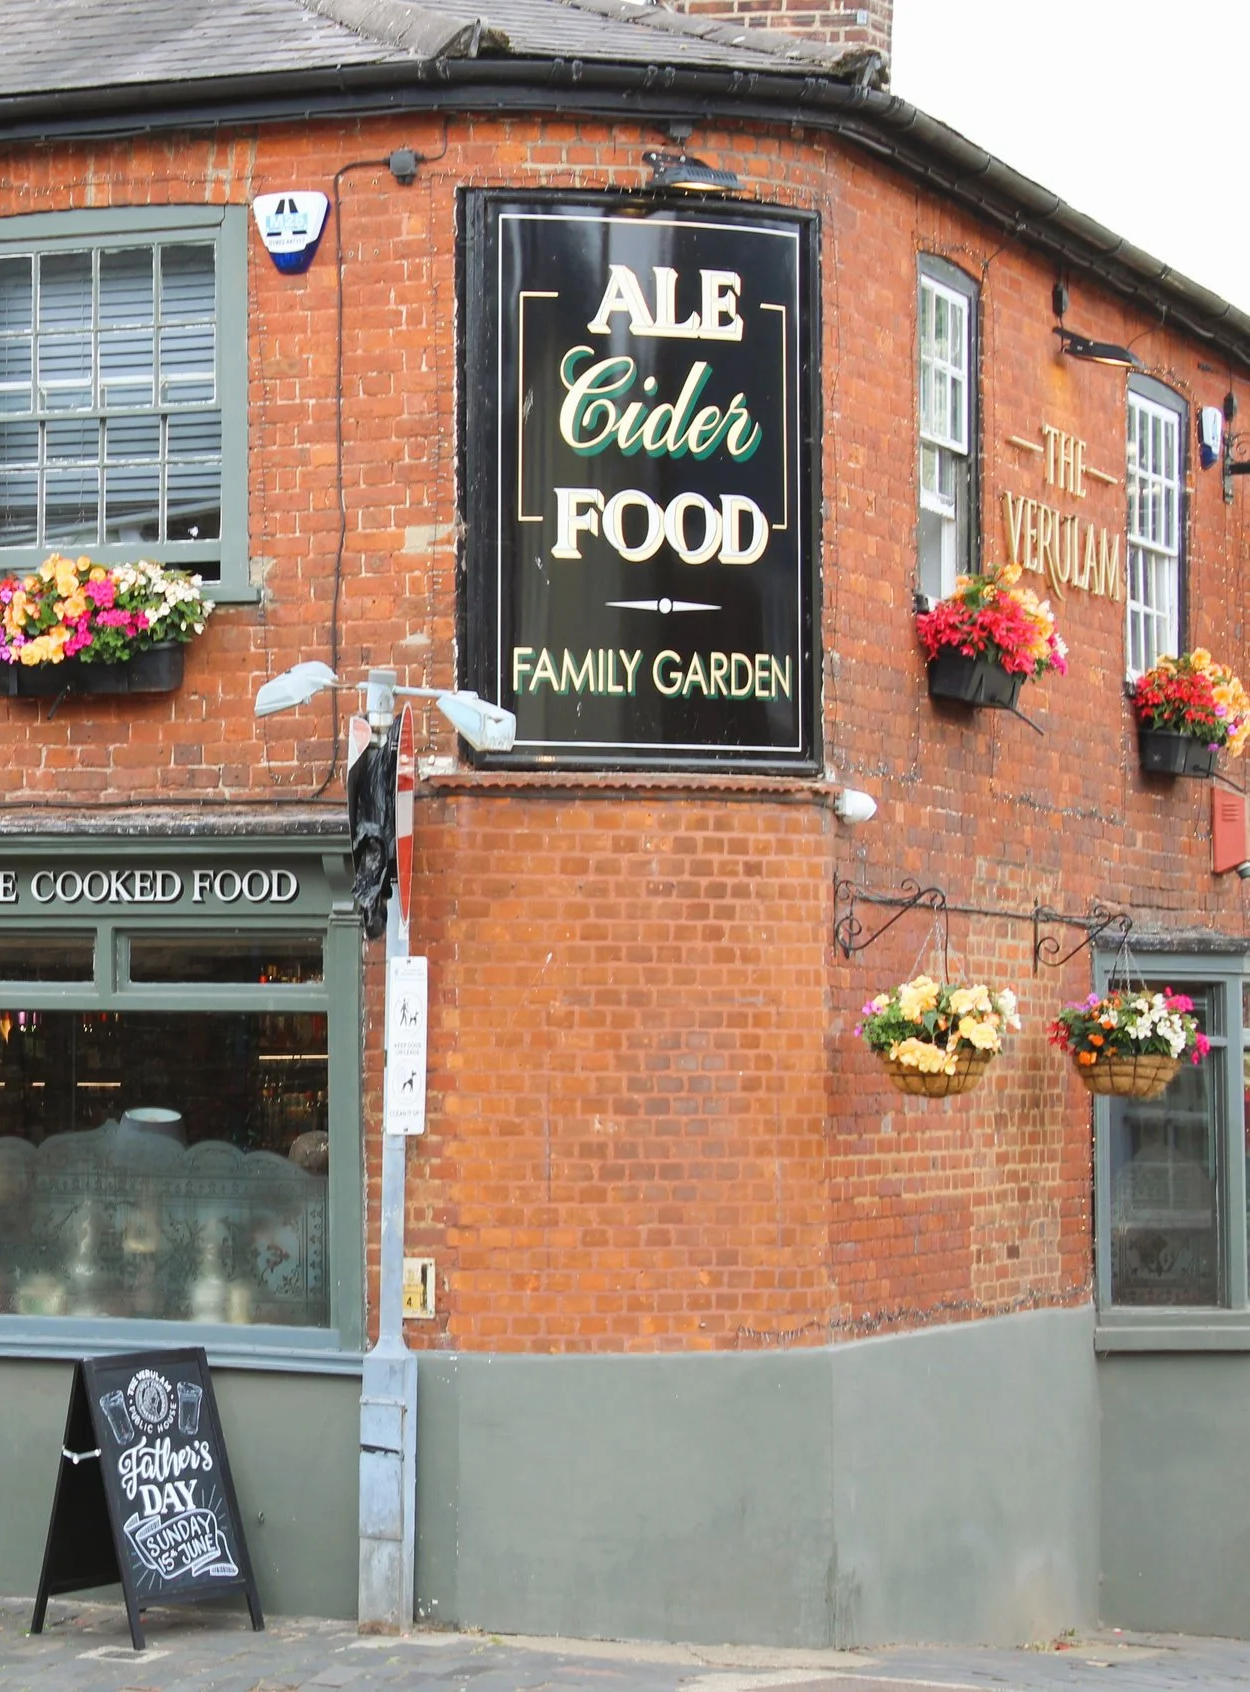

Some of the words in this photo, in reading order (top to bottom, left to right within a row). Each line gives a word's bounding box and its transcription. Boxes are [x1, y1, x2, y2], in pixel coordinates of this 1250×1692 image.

[588, 264, 744, 342] ALE
[559, 345, 762, 462] Cider
[1041, 422, 1087, 499] THE
[550, 487, 769, 565] FOOD
[1001, 490, 1121, 602] VERULAM
[512, 647, 643, 697] FAMILY
[652, 649, 793, 700] GARDEN
[30, 869, 183, 903] COOKED
[192, 868, 300, 903] FOOD
[127, 1376, 139, 1396] THE
[135, 1369, 172, 1392] VERULAM
[129, 1405, 153, 1434] PUBLIC
[157, 1401, 177, 1433] HOUSE
[118, 1435, 213, 1501] Father's
[139, 1479, 198, 1516] DAY
[146, 1513, 211, 1557] SUNDAY
[158, 1549, 178, 1573] 15th
[177, 1533, 216, 1564] JUNE
